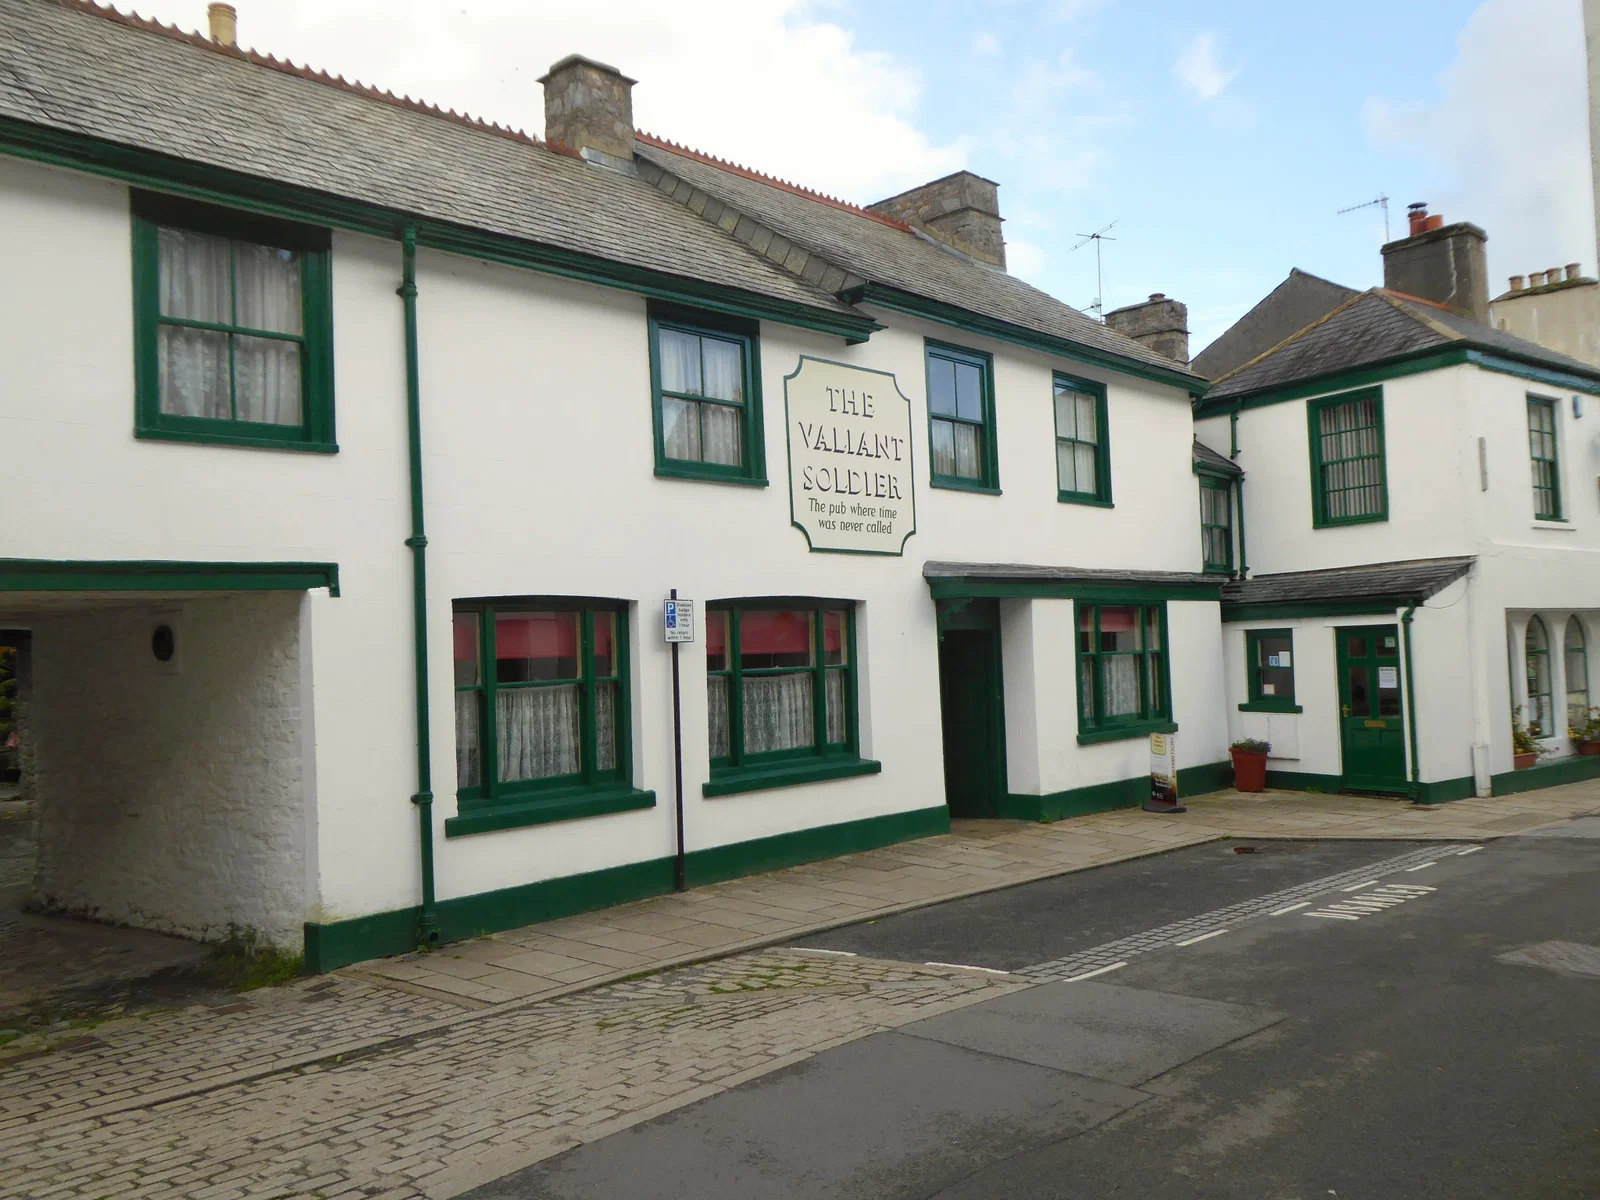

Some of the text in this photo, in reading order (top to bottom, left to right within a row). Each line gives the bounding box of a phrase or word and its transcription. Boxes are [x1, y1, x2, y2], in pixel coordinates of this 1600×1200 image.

[825, 386, 875, 418] THE
[798, 421, 904, 461] VALIANT
[803, 466, 902, 500] SOLDIER
[808, 498, 897, 519] The pub where time
[818, 519, 892, 534] was never called
[667, 602, 674, 614] P
[1302, 884, 1438, 920] DISABLED
